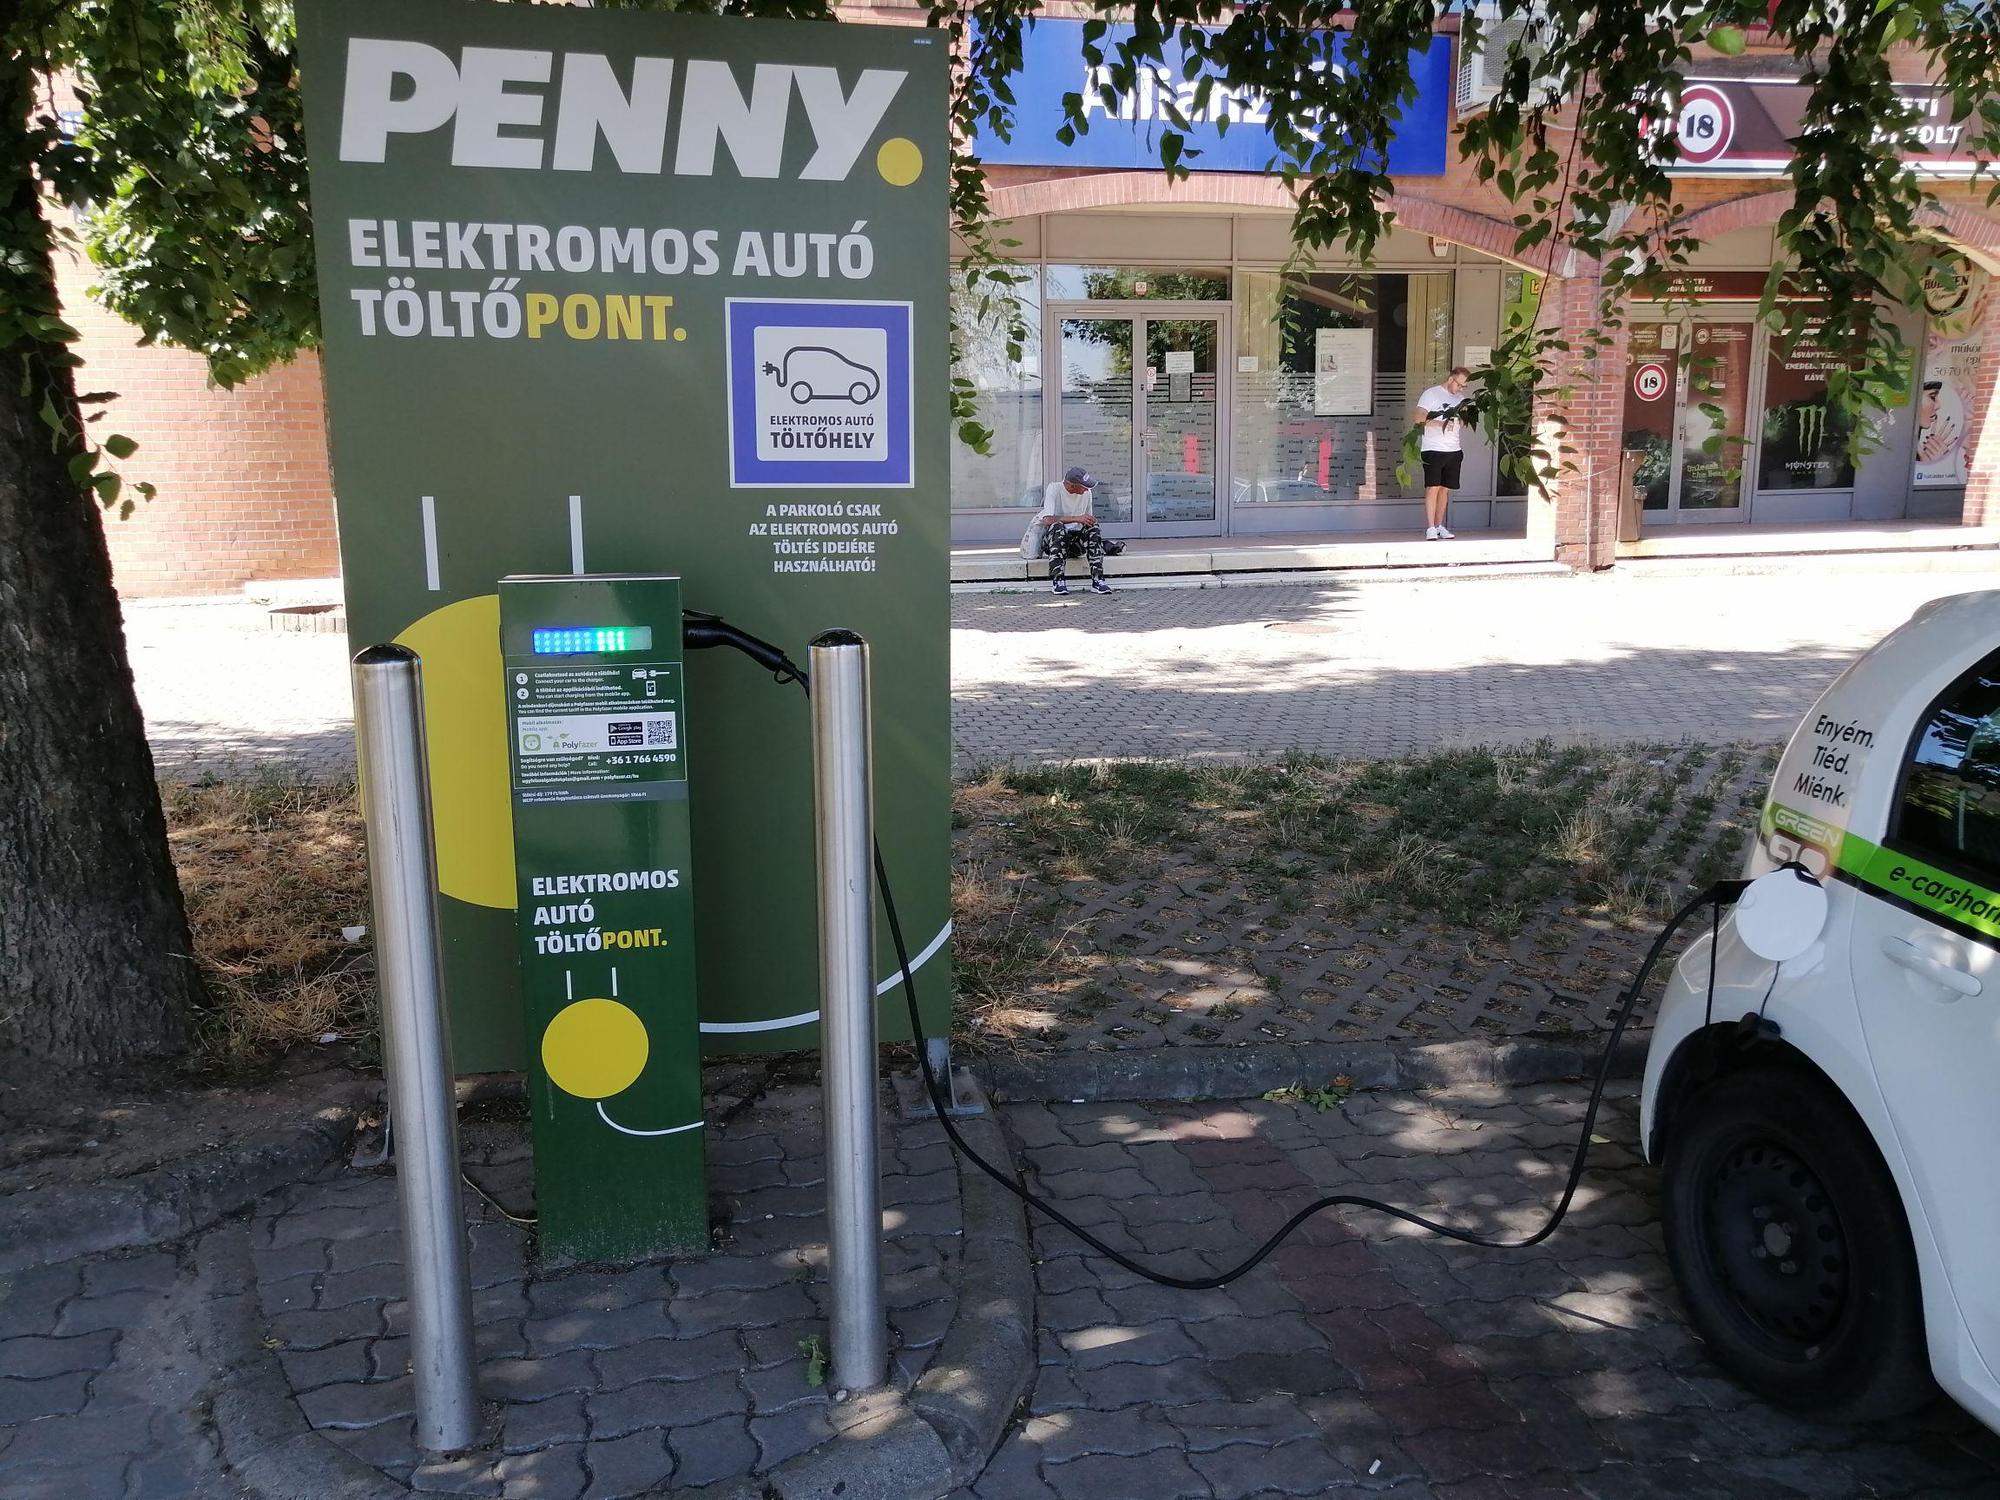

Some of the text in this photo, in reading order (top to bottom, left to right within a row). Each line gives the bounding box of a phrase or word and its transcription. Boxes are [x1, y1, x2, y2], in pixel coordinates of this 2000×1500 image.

[339, 37, 924, 187] PENNY.
[1685, 114, 1714, 139] 18
[348, 218, 875, 279] ELEKTROMOS AUTÓ
[350, 277, 687, 342] TÖLTŐPONT.
[1644, 376, 1658, 388] 18
[770, 414, 874, 426] ELEKTROMOS AUTÓ
[770, 427, 874, 449] TÖLTŐHELY
[766, 501, 881, 517] A PARKOLÓ CSAK
[749, 520, 898, 536] AZ ELEKTROMOS AUTÓ
[773, 538, 875, 554] TÖLTÉS IDEJÉRE
[774, 557, 876, 572] HASZNÁLHATÓ!
[1814, 714, 1874, 748] Enyém.
[606, 756, 623, 764] +36
[633, 755, 651, 763] 766
[652, 754, 676, 762] 4590
[1813, 745, 1848, 775] Tiéd.
[1793, 773, 1846, 808] Miénk.
[1776, 808, 1841, 848] GREEN
[532, 869, 680, 896] ELEKTROMOS
[534, 898, 594, 926] AUTÓ
[534, 926, 668, 954] TÖLTŐPONT.
